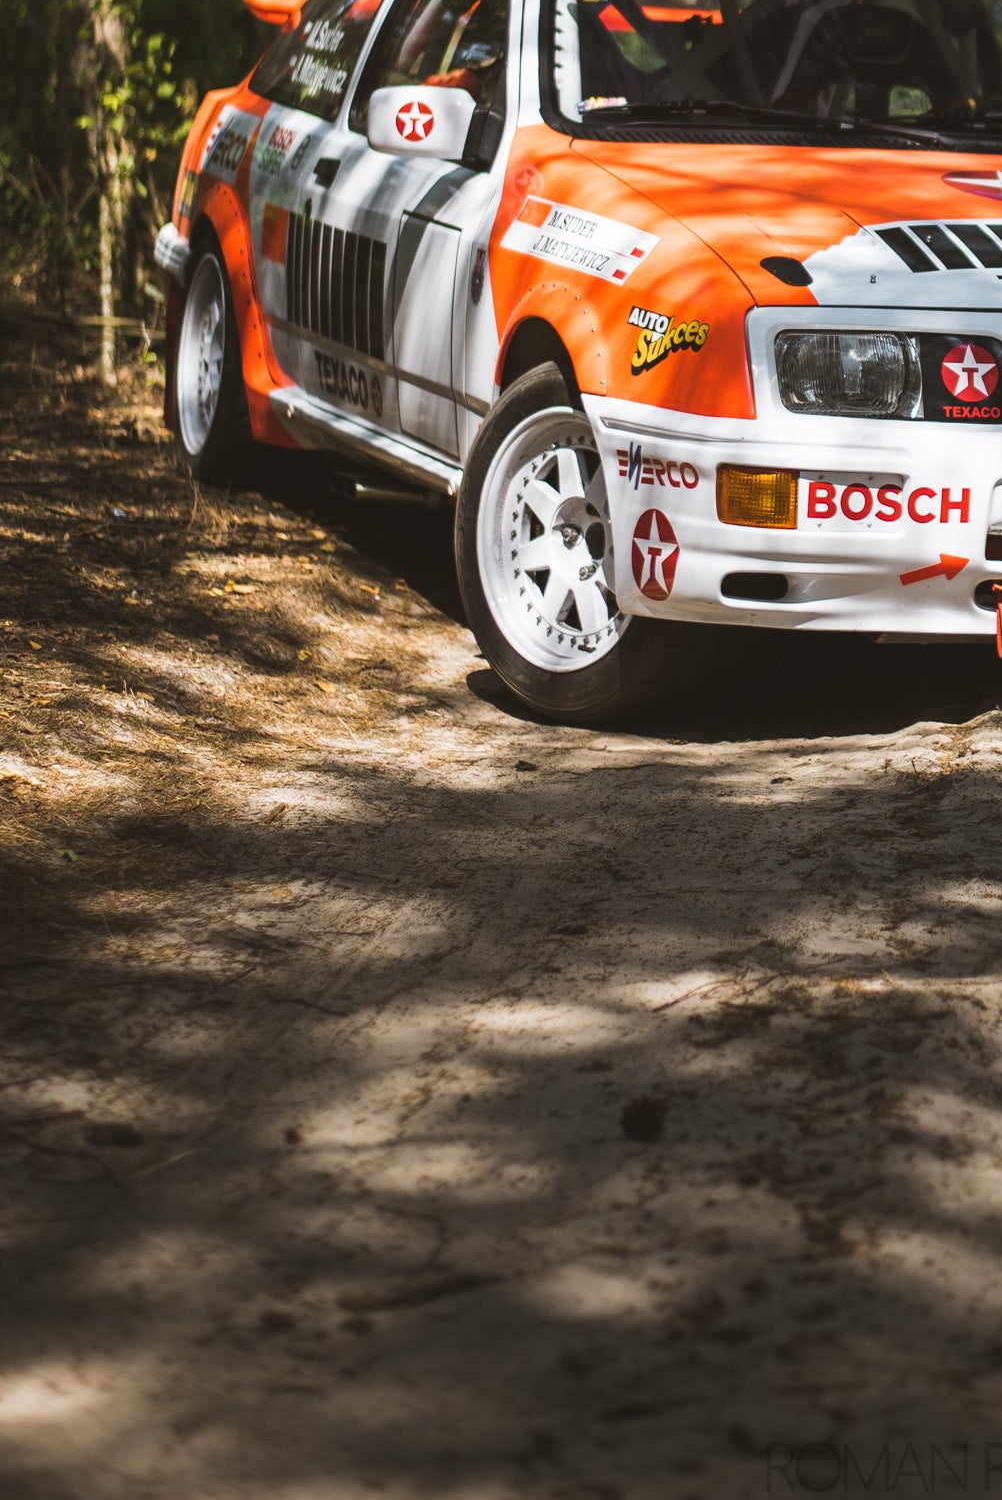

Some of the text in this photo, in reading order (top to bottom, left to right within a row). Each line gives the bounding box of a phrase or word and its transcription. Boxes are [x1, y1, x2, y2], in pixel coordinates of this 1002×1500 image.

[548, 210, 599, 238] M.SUDER
[532, 235, 610, 272] J.MATYJEWICZ
[628, 307, 669, 334] AUTO
[631, 315, 710, 368] Sukces
[314, 349, 369, 411] TEXACO
[943, 405, 1001, 418] TEXACO
[807, 481, 972, 523] BOSCH
